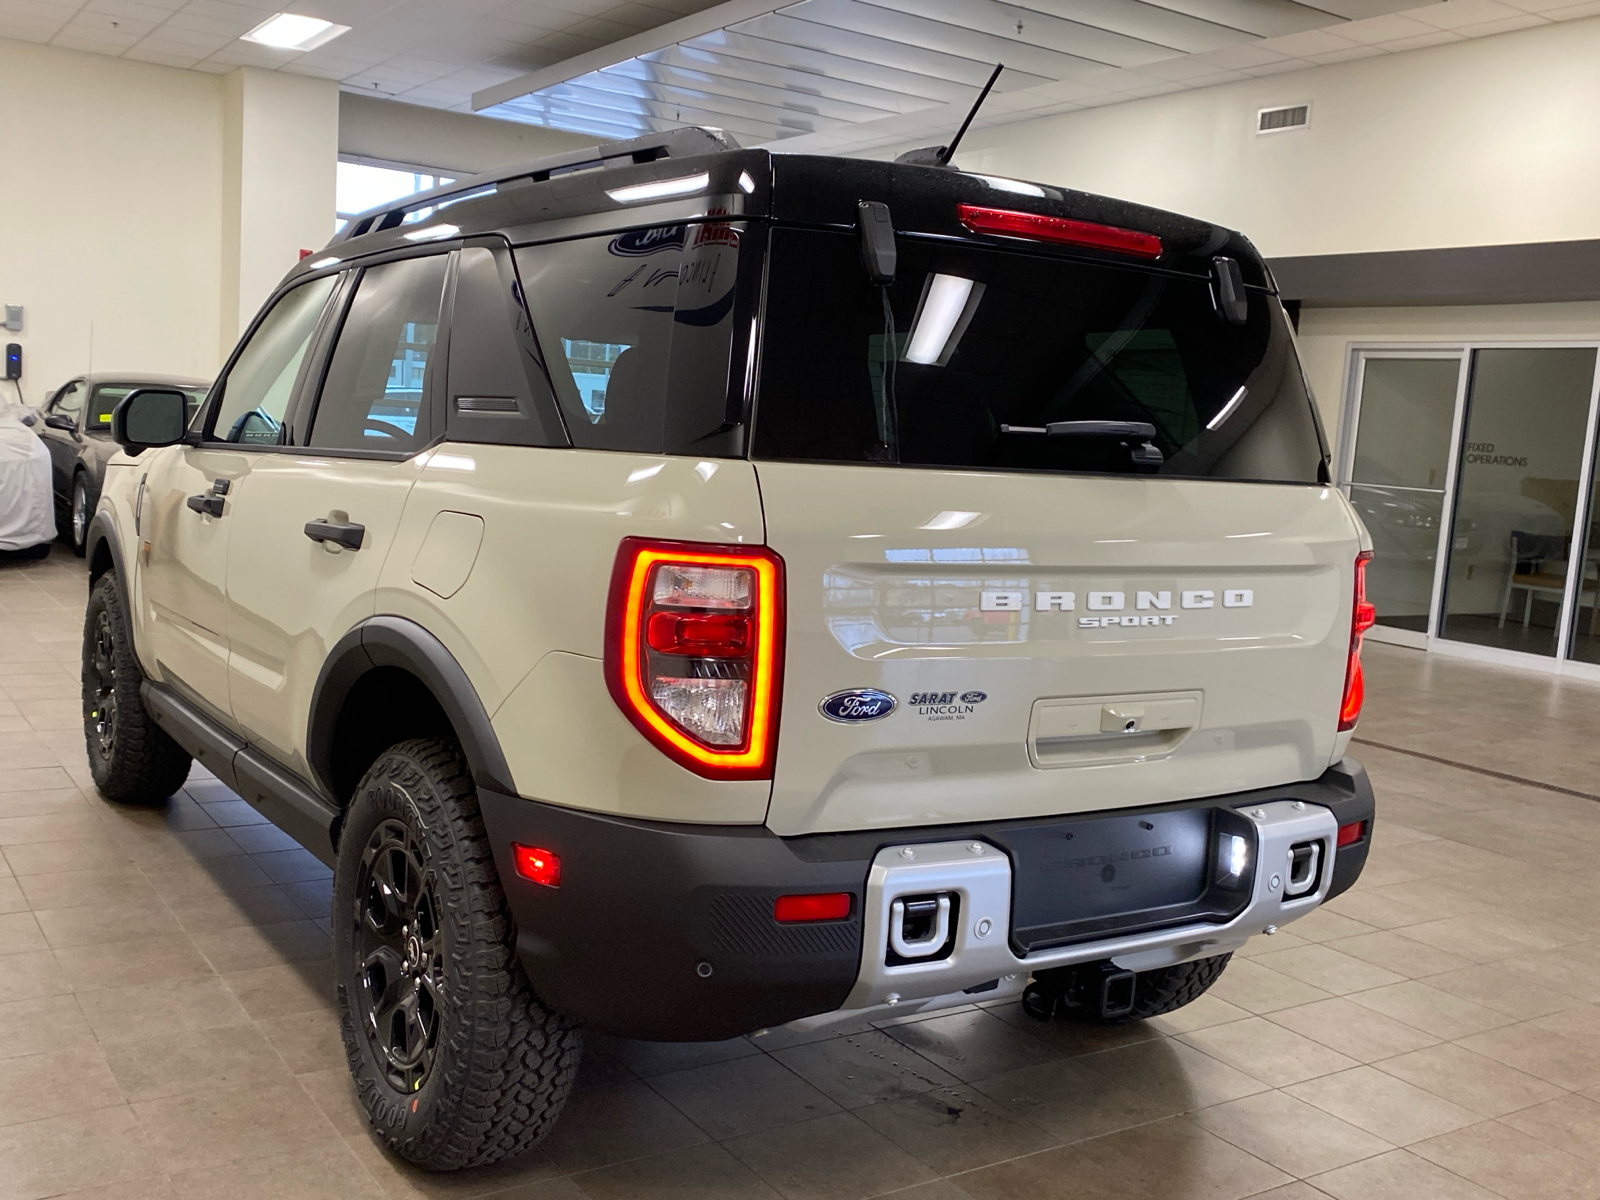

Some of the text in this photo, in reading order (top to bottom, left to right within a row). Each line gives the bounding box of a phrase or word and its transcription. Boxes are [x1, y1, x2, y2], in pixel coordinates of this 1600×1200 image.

[1467, 442, 1494, 453] FIXED
[1466, 453, 1528, 467] OPERATIONS
[980, 589, 1254, 611] BRONCO
[1078, 614, 1178, 628] SPORT
[909, 691, 983, 706] SARAT Ford
[839, 696, 881, 716] Ford
[918, 705, 974, 715] LINCOLN
